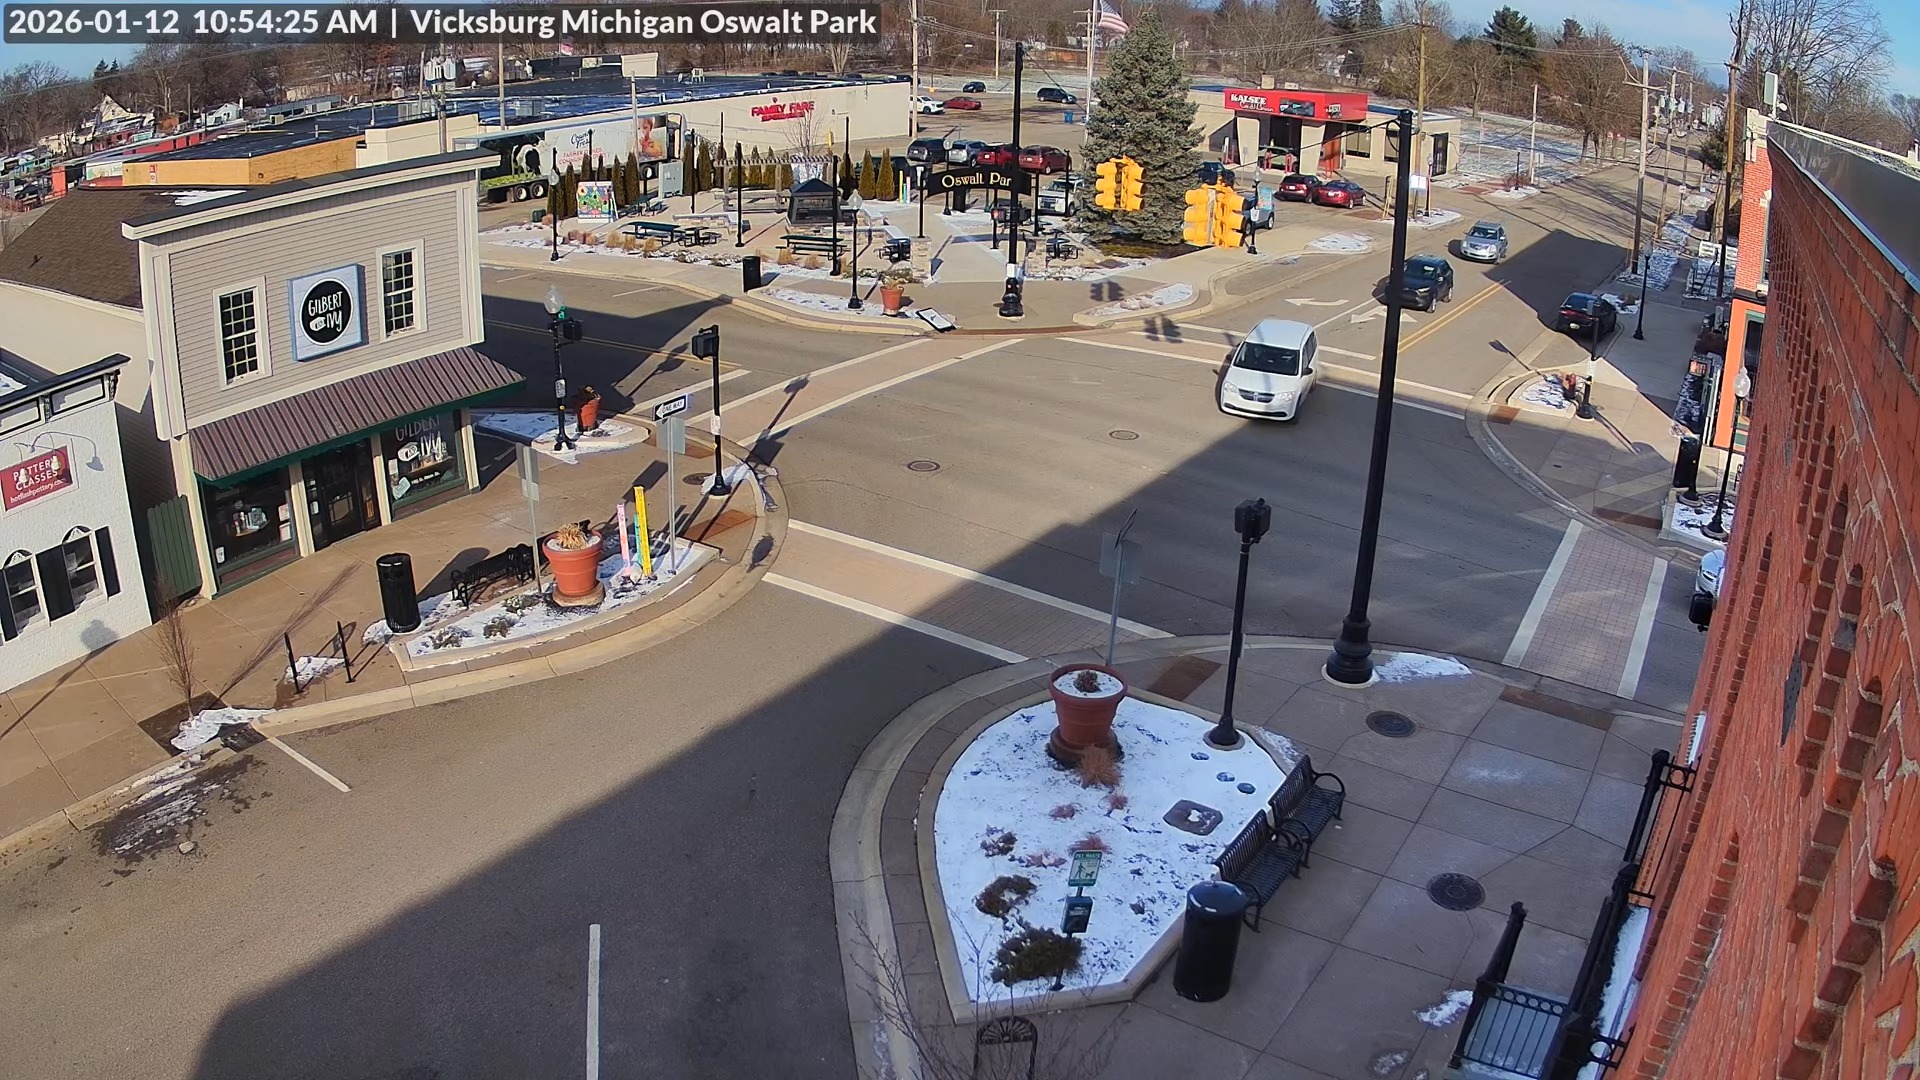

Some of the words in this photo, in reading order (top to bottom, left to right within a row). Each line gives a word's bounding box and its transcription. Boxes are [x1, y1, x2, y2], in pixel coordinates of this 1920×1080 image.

[751, 104, 785, 116] FAMILY
[789, 101, 814, 113] FARE
[942, 172, 985, 188] Oswalt
[308, 291, 343, 317] GILBERT
[15, 470, 58, 491] CLASSES
